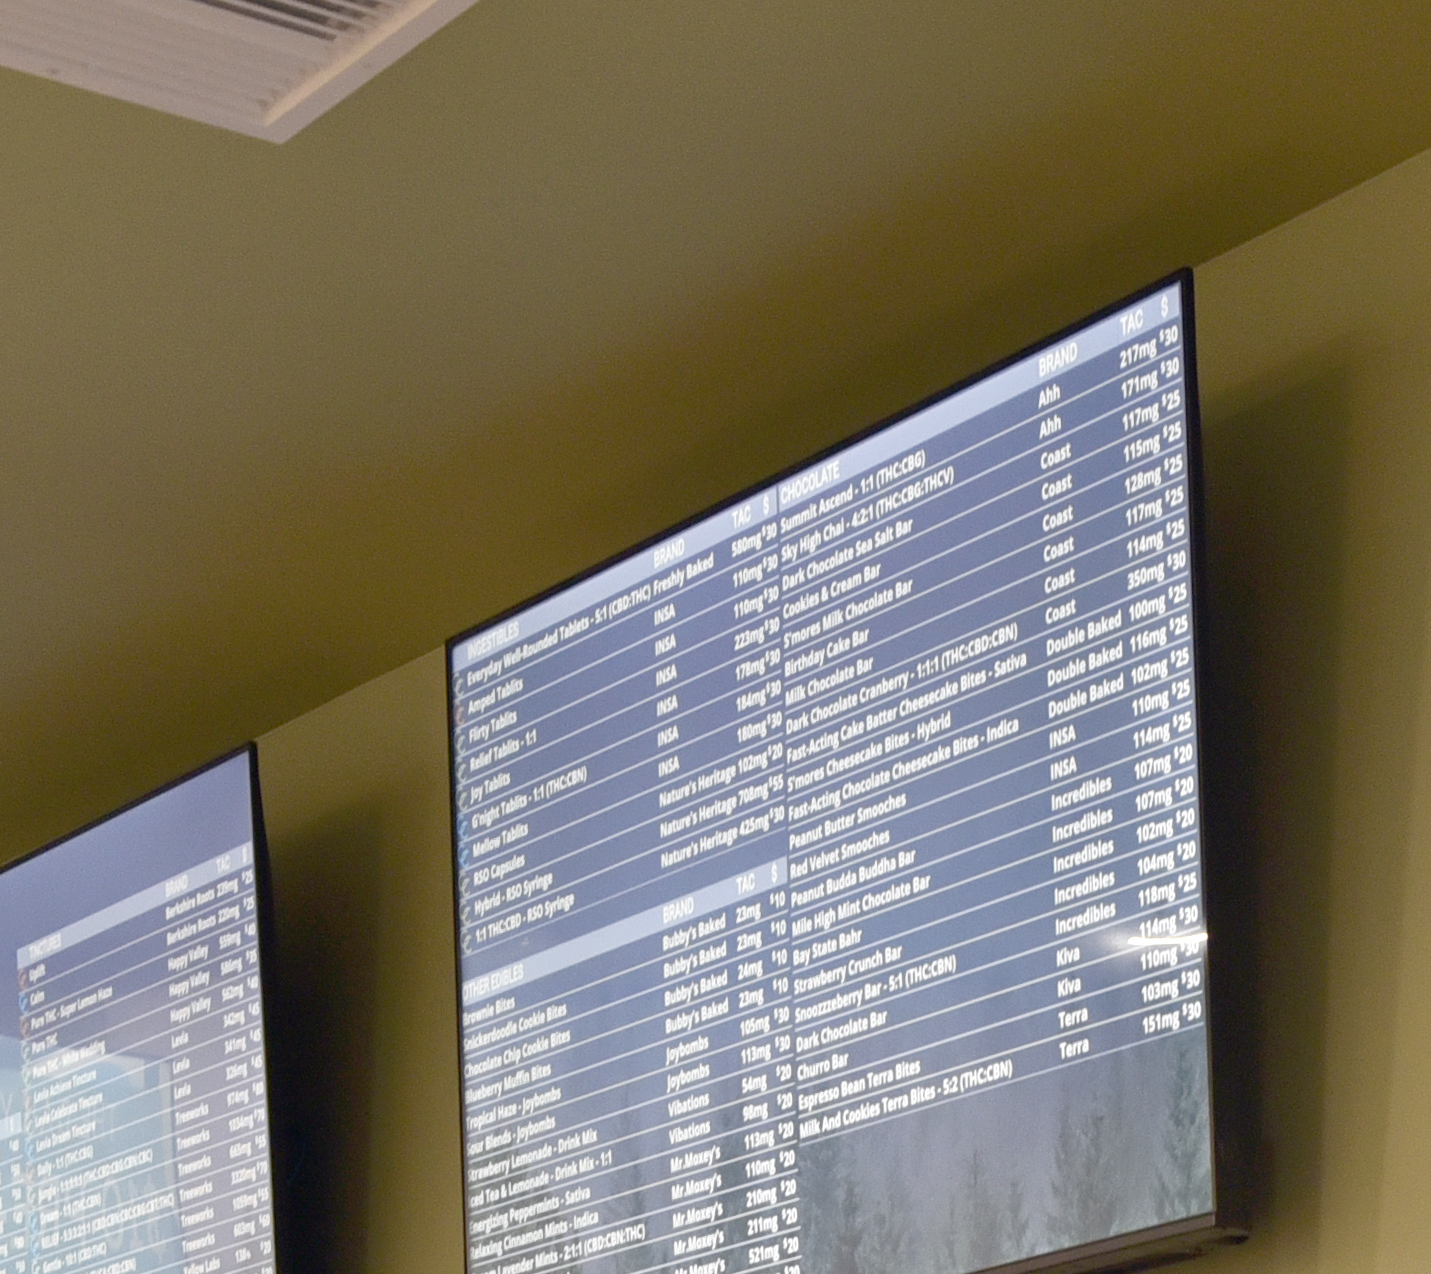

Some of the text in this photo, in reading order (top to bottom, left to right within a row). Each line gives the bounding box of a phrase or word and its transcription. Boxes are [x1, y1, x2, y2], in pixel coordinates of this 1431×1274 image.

[1041, 443, 1071, 469] Coast
[781, 460, 840, 504] CHOCOLATE
[782, 519, 913, 591] Dark Chocolate Sea Salt Bar
[1046, 609, 1122, 656] Double Baked
[1049, 725, 1076, 749] INSA
[1051, 777, 1112, 811] Incredibles
[789, 794, 906, 850] Peanut Butter Smooches
